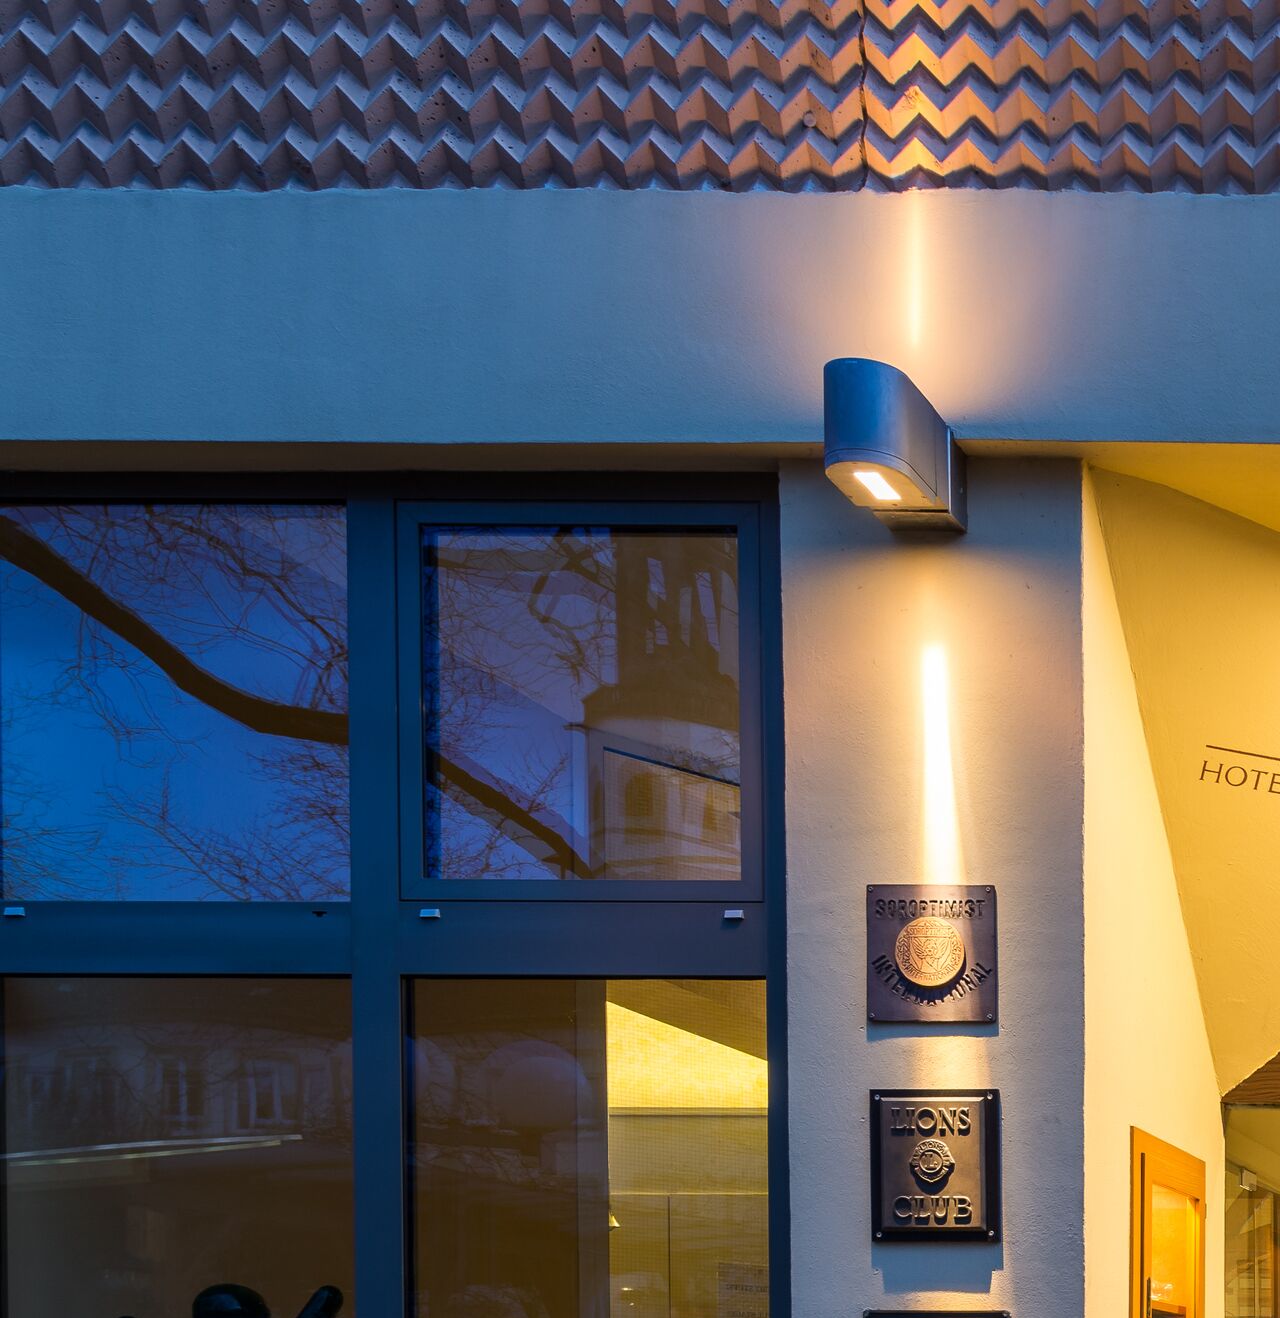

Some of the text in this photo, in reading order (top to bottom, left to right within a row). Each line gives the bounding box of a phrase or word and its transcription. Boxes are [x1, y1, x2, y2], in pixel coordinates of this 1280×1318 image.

[875, 898, 986, 918] SOROPTIMIST
[871, 954, 992, 1007] INTEONAL
[890, 1107, 971, 1131] LIONS
[894, 1195, 972, 1219] CLUB
